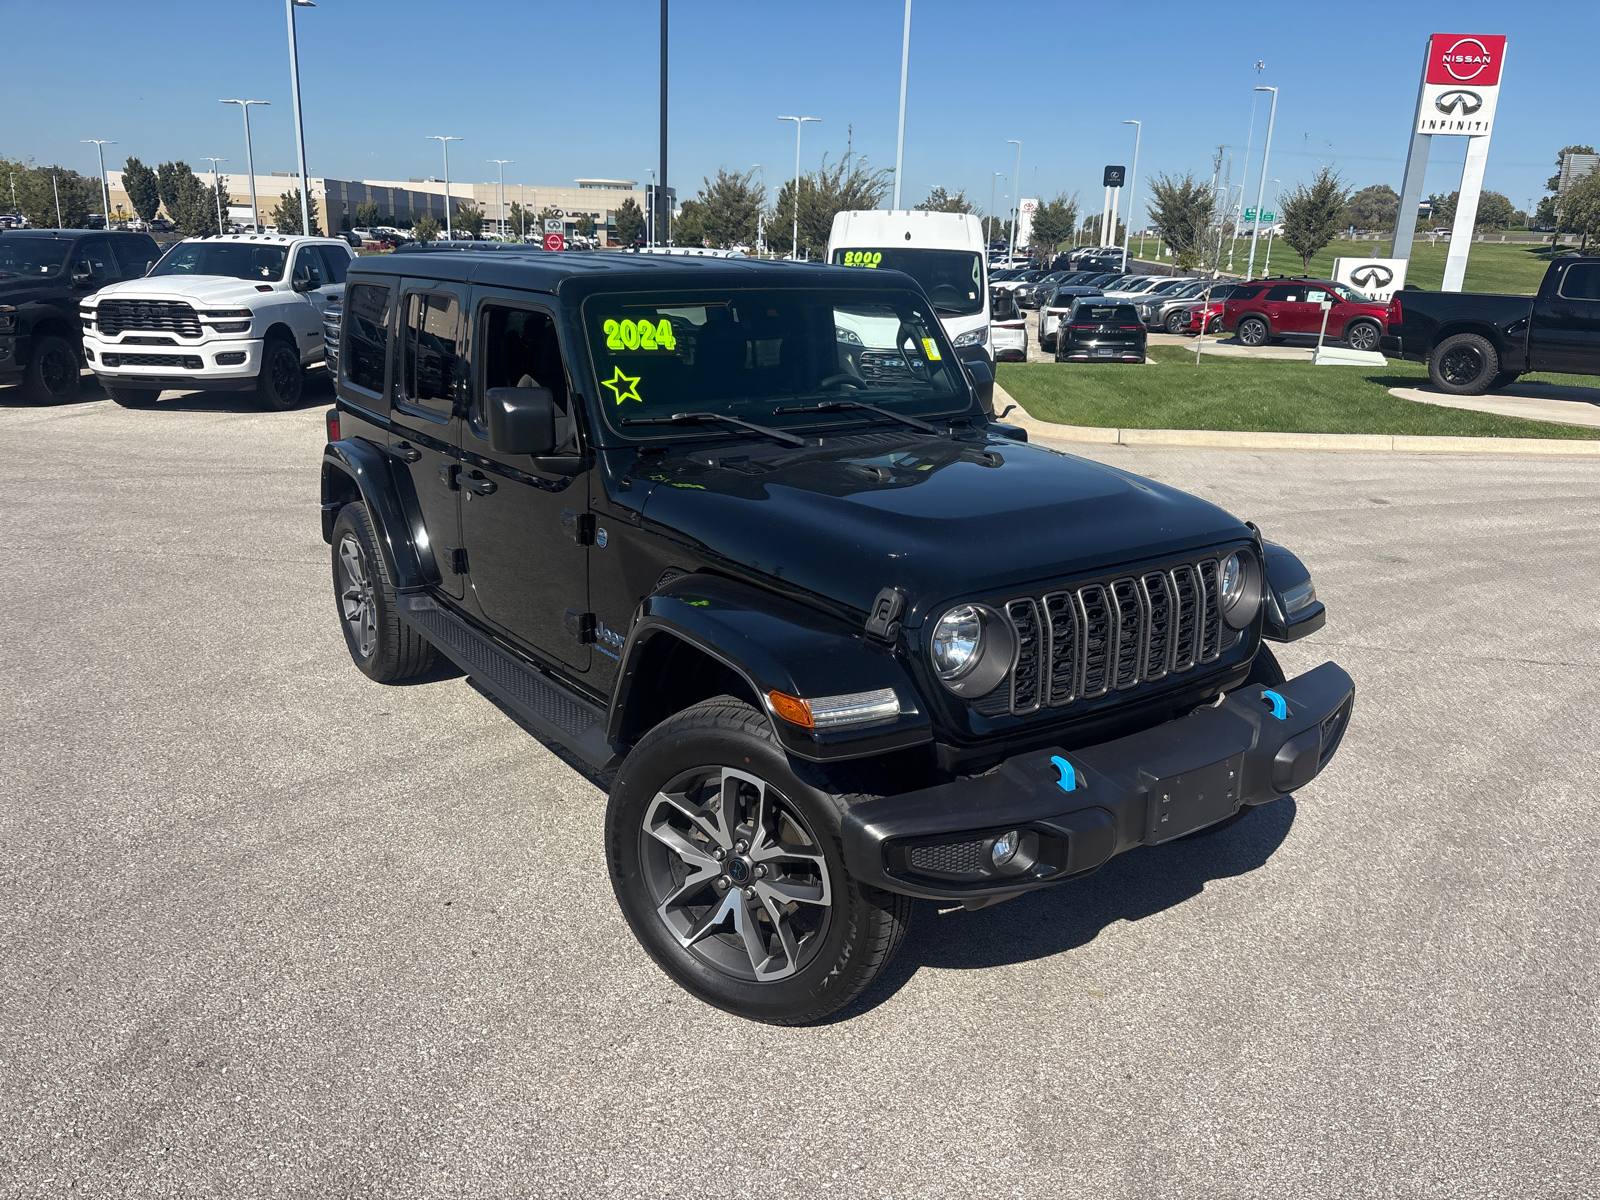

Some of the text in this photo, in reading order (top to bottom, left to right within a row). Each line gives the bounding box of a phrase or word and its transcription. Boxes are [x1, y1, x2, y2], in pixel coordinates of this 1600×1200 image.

[1442, 54, 1491, 63] NISSAN
[1421, 119, 1489, 131] INFINITI
[844, 251, 882, 264] 8000
[603, 318, 677, 350] 2024
